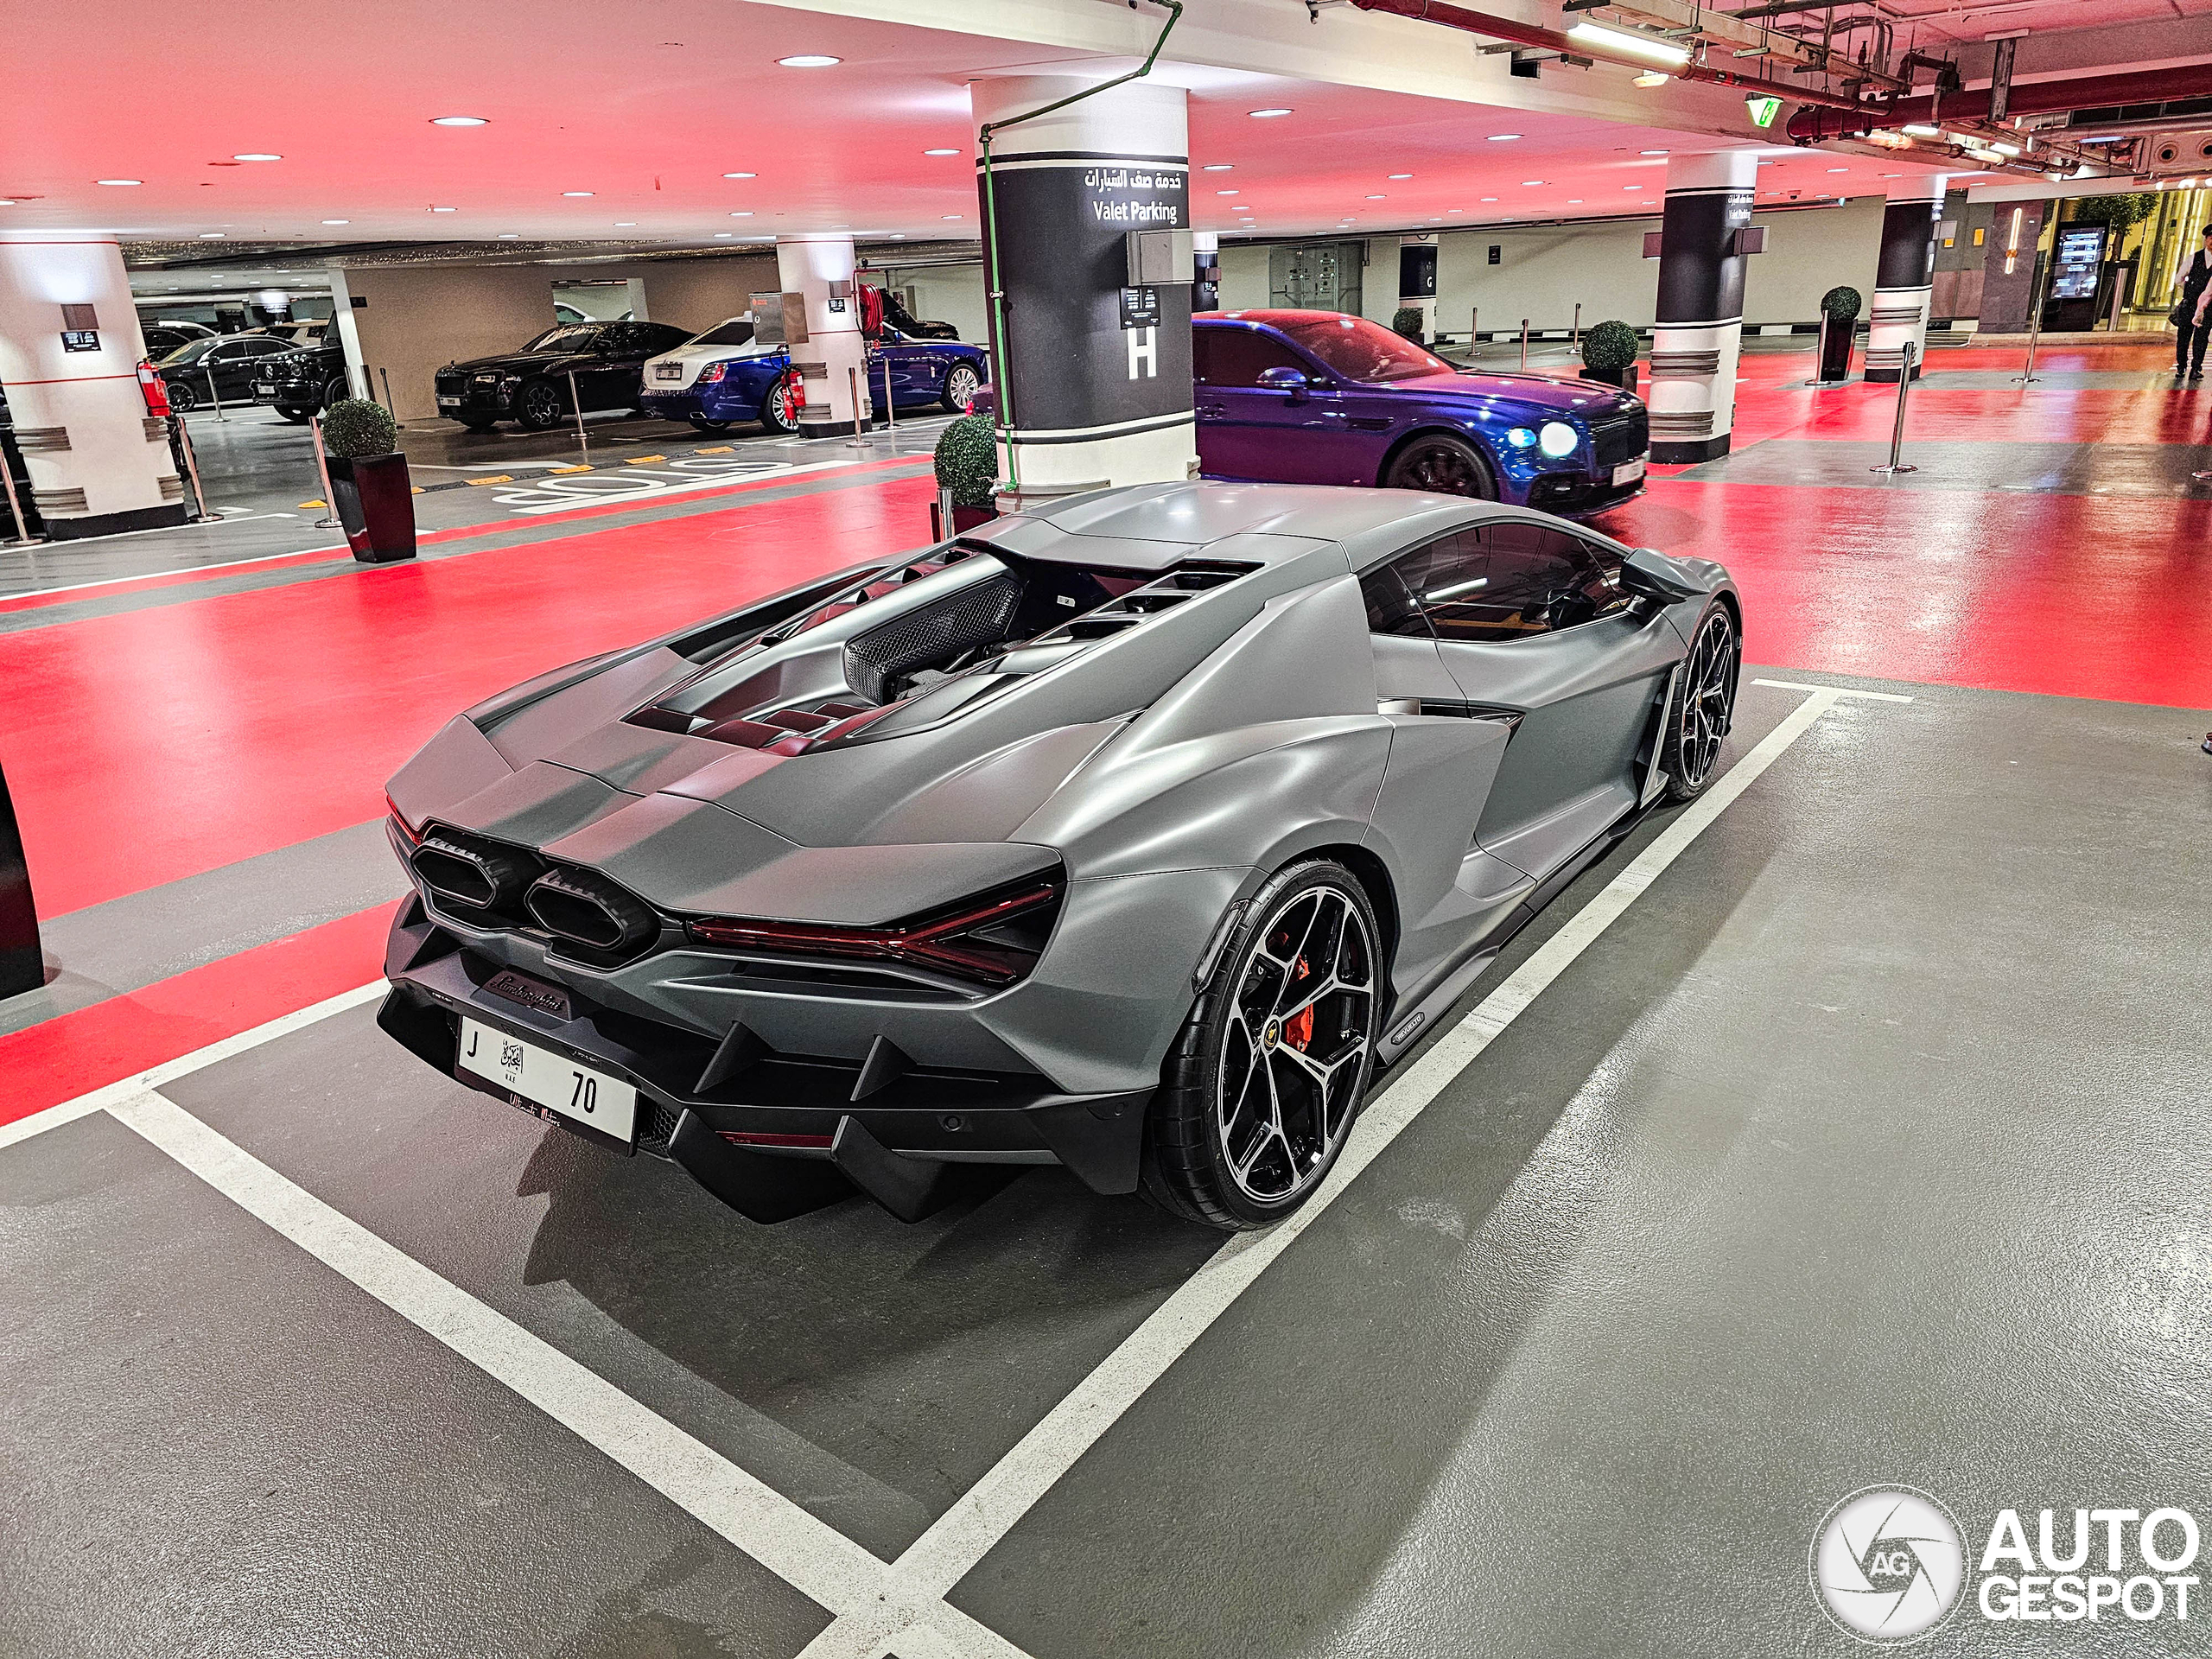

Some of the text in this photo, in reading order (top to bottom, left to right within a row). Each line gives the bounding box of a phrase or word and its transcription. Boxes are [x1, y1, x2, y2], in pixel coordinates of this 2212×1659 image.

[1129, 169, 1153, 188] صف
[1154, 172, 1181, 189] خدمة
[1092, 200, 1178, 225] Valet Parking
[1427, 276, 1433, 288] G
[1127, 325, 1157, 380] H
[491, 458, 793, 505] STOP
[490, 975, 565, 1011] Lamborghini
[1396, 1014, 1421, 1040] REVUELTO
[467, 1030, 478, 1058] J
[570, 1071, 596, 1113] 70
[509, 1092, 561, 1127] Ultimate Motors
